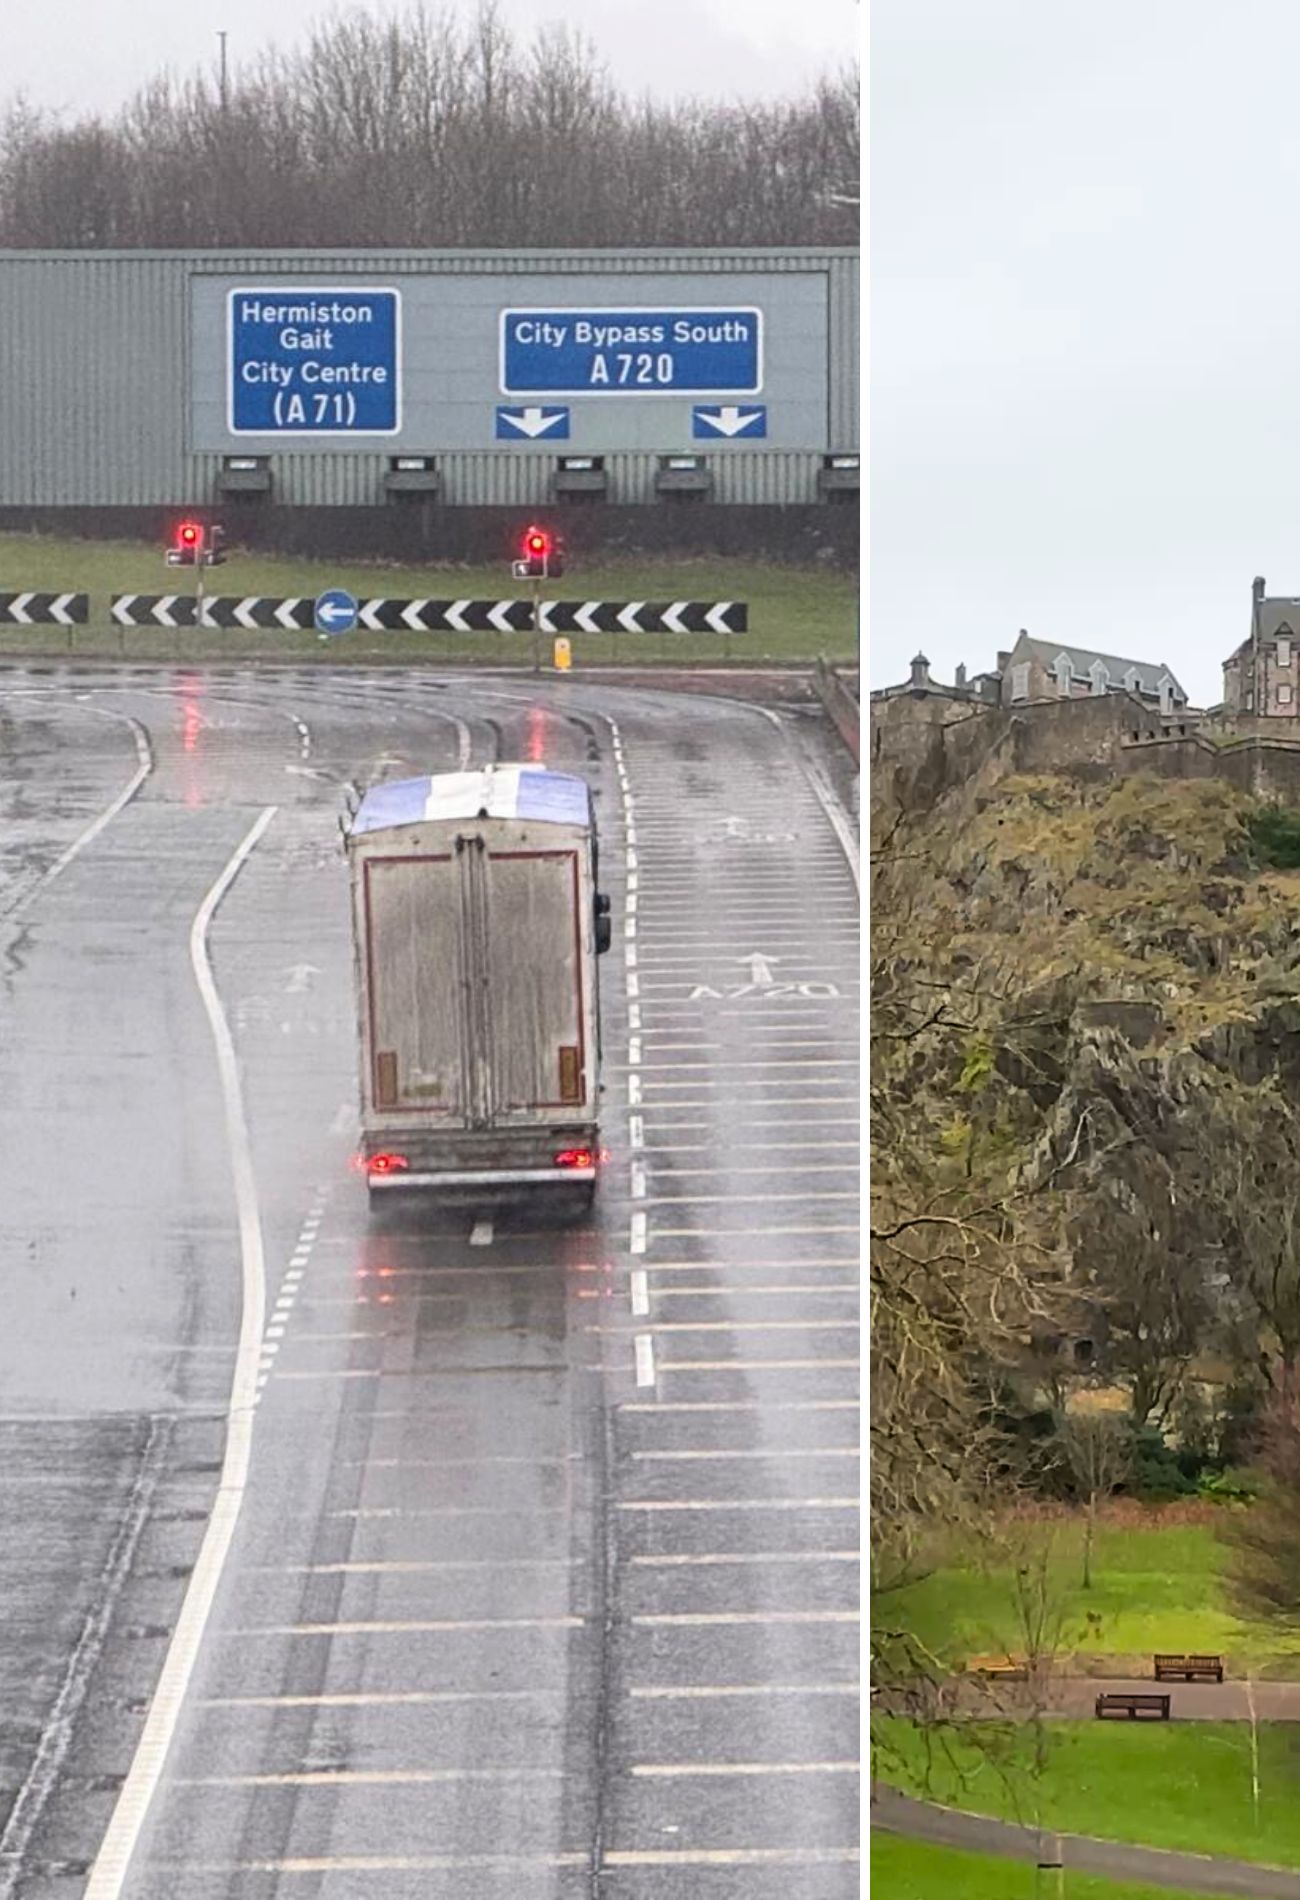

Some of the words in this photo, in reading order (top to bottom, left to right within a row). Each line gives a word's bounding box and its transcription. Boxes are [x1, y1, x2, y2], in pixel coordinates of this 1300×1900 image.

[241, 301, 372, 323] Hermiston
[280, 328, 333, 349] Gait
[515, 322, 567, 347] City
[575, 322, 664, 346] Bypass
[674, 321, 749, 343] South
[242, 361, 294, 386] City
[301, 361, 387, 383] Centre
